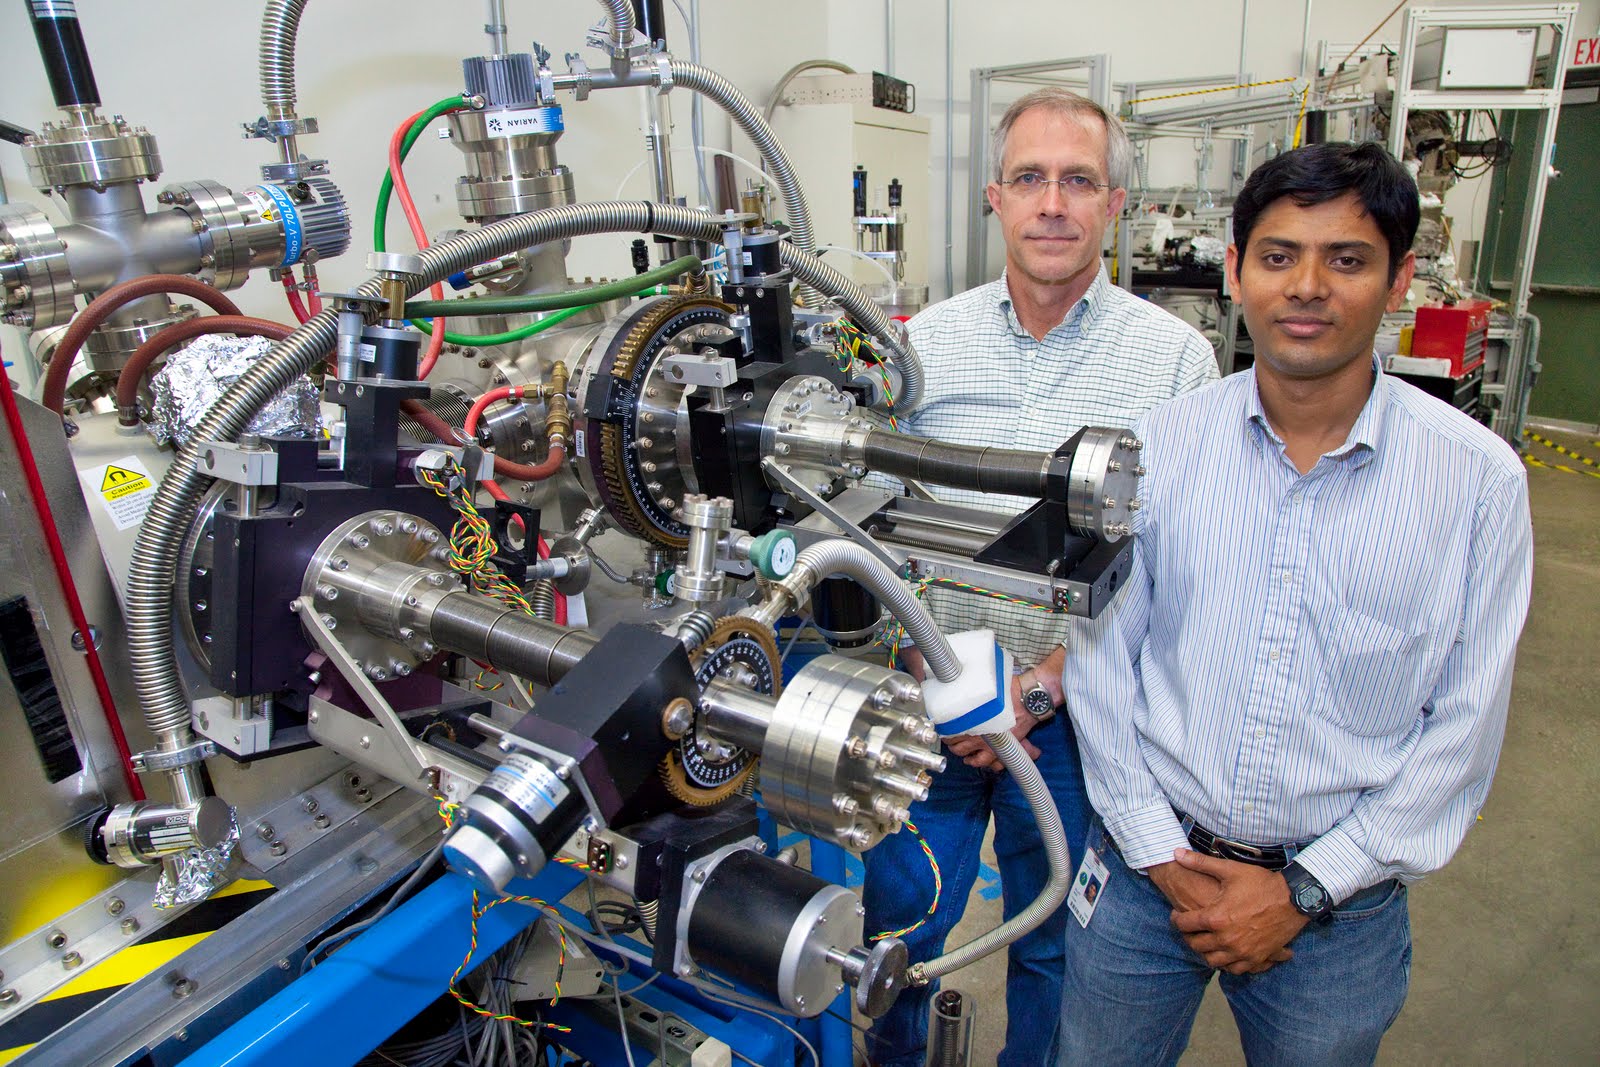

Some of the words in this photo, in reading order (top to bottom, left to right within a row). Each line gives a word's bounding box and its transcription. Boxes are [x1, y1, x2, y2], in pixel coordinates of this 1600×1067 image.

[507, 117, 538, 127] VARIAN
[279, 201, 296, 226] 70LP
[286, 228, 299, 263] Turbo-V
[111, 481, 144, 495] Caution
[165, 814, 189, 826] MDC
